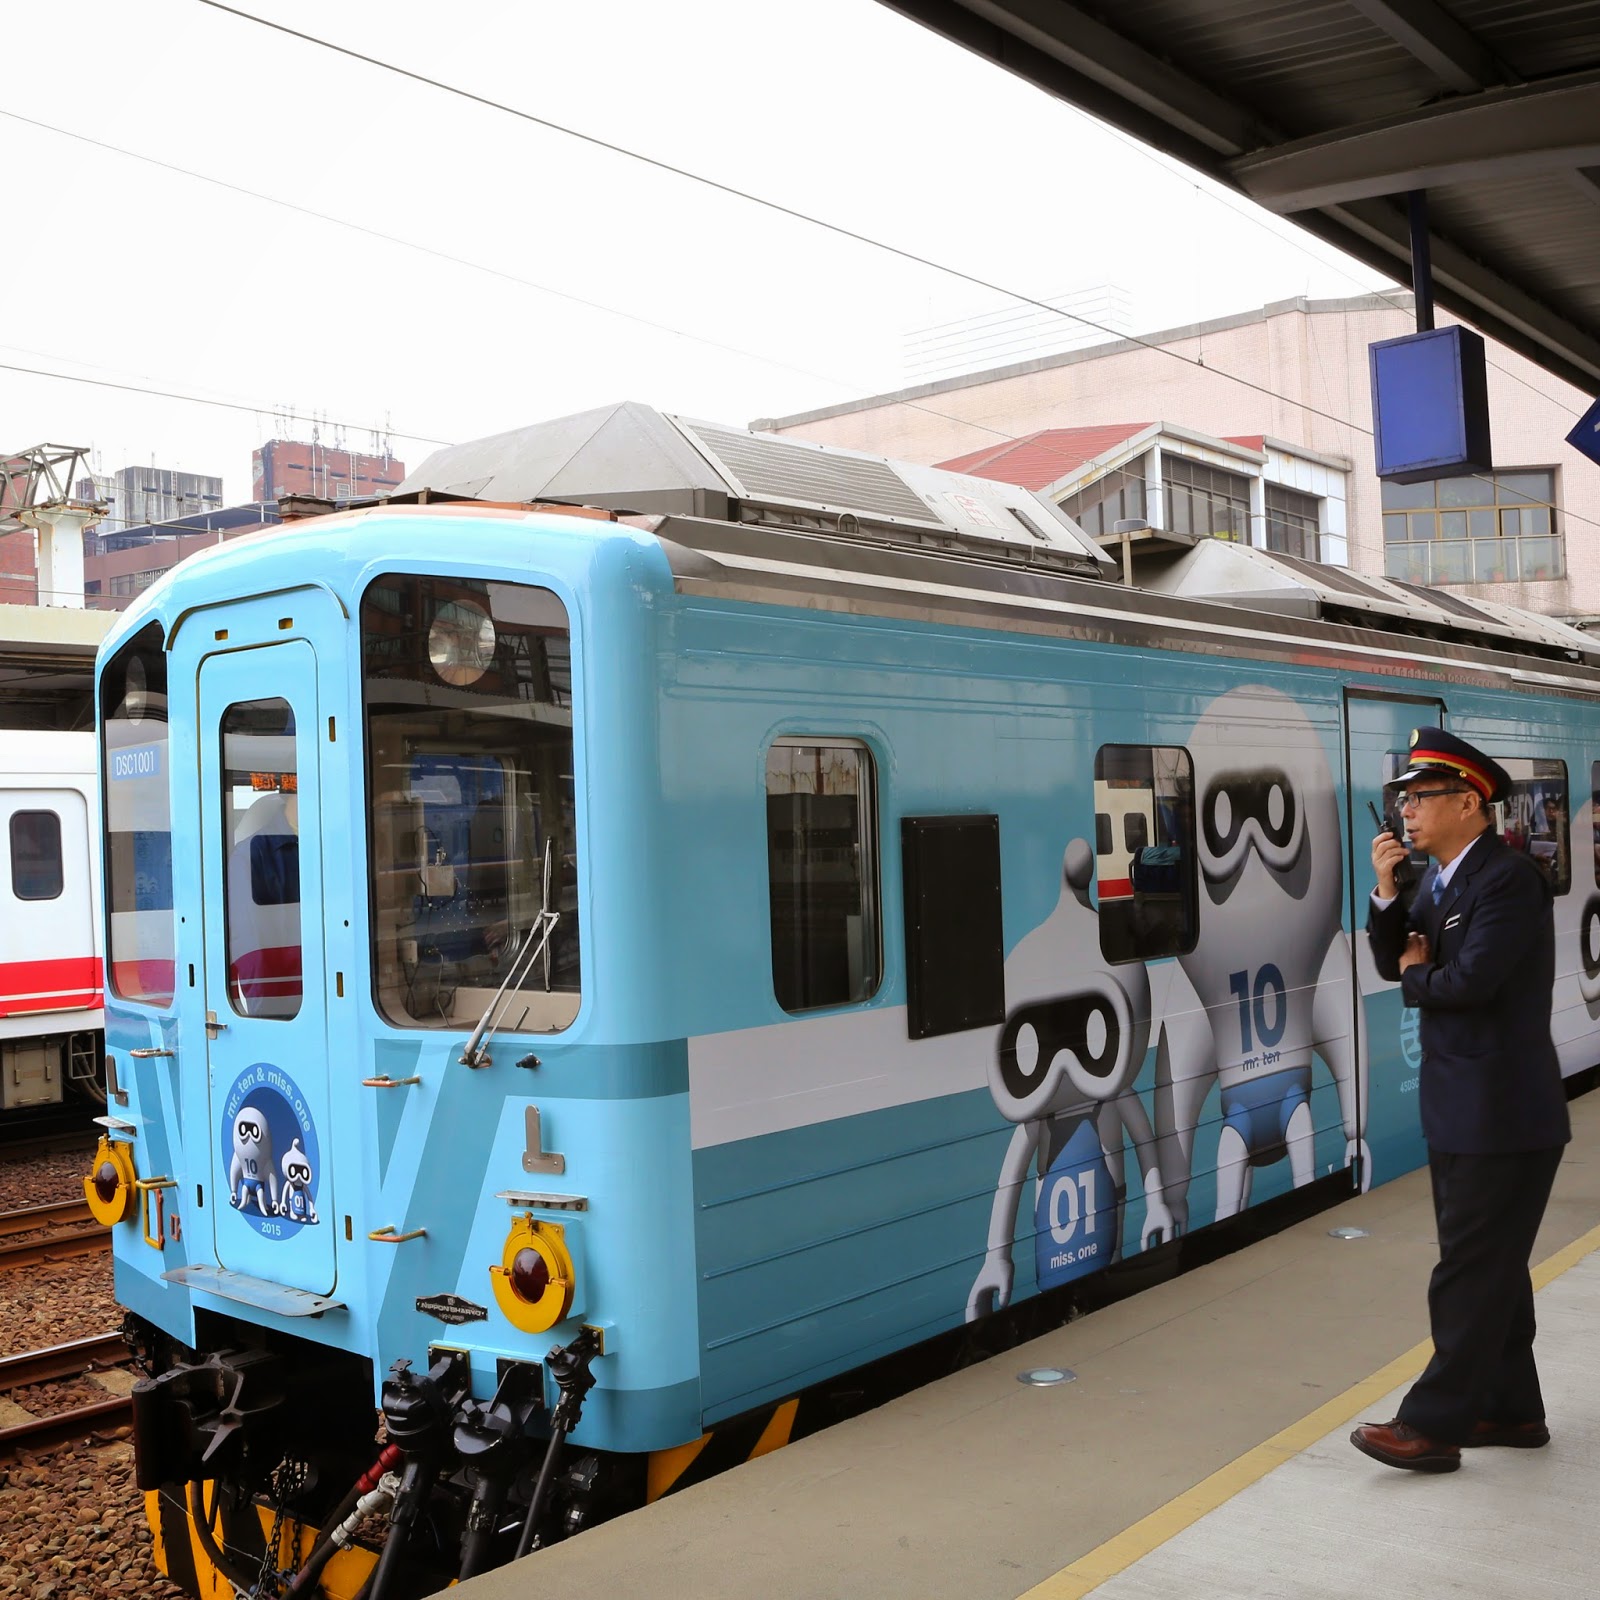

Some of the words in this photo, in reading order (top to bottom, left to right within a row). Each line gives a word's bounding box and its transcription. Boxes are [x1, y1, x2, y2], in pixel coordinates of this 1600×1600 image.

[116, 751, 154, 776] DSC1001
[1229, 963, 1287, 1055] 10
[1242, 1056, 1260, 1072] mr.
[1263, 1050, 1281, 1066] ten
[1400, 1076, 1420, 1094] 45DSC
[227, 1093, 240, 1119] mr.
[238, 1073, 255, 1094] ten
[256, 1066, 266, 1082] &
[267, 1070, 294, 1100] miss.
[294, 1099, 311, 1132] one
[244, 1158, 258, 1175] 10
[294, 1195, 304, 1208] 01
[1049, 1168, 1097, 1245] 01
[261, 1221, 281, 1236] 2015
[1050, 1251, 1076, 1269] miss.
[1078, 1242, 1098, 1260] one
[420, 1302, 450, 1312] NIPPON
